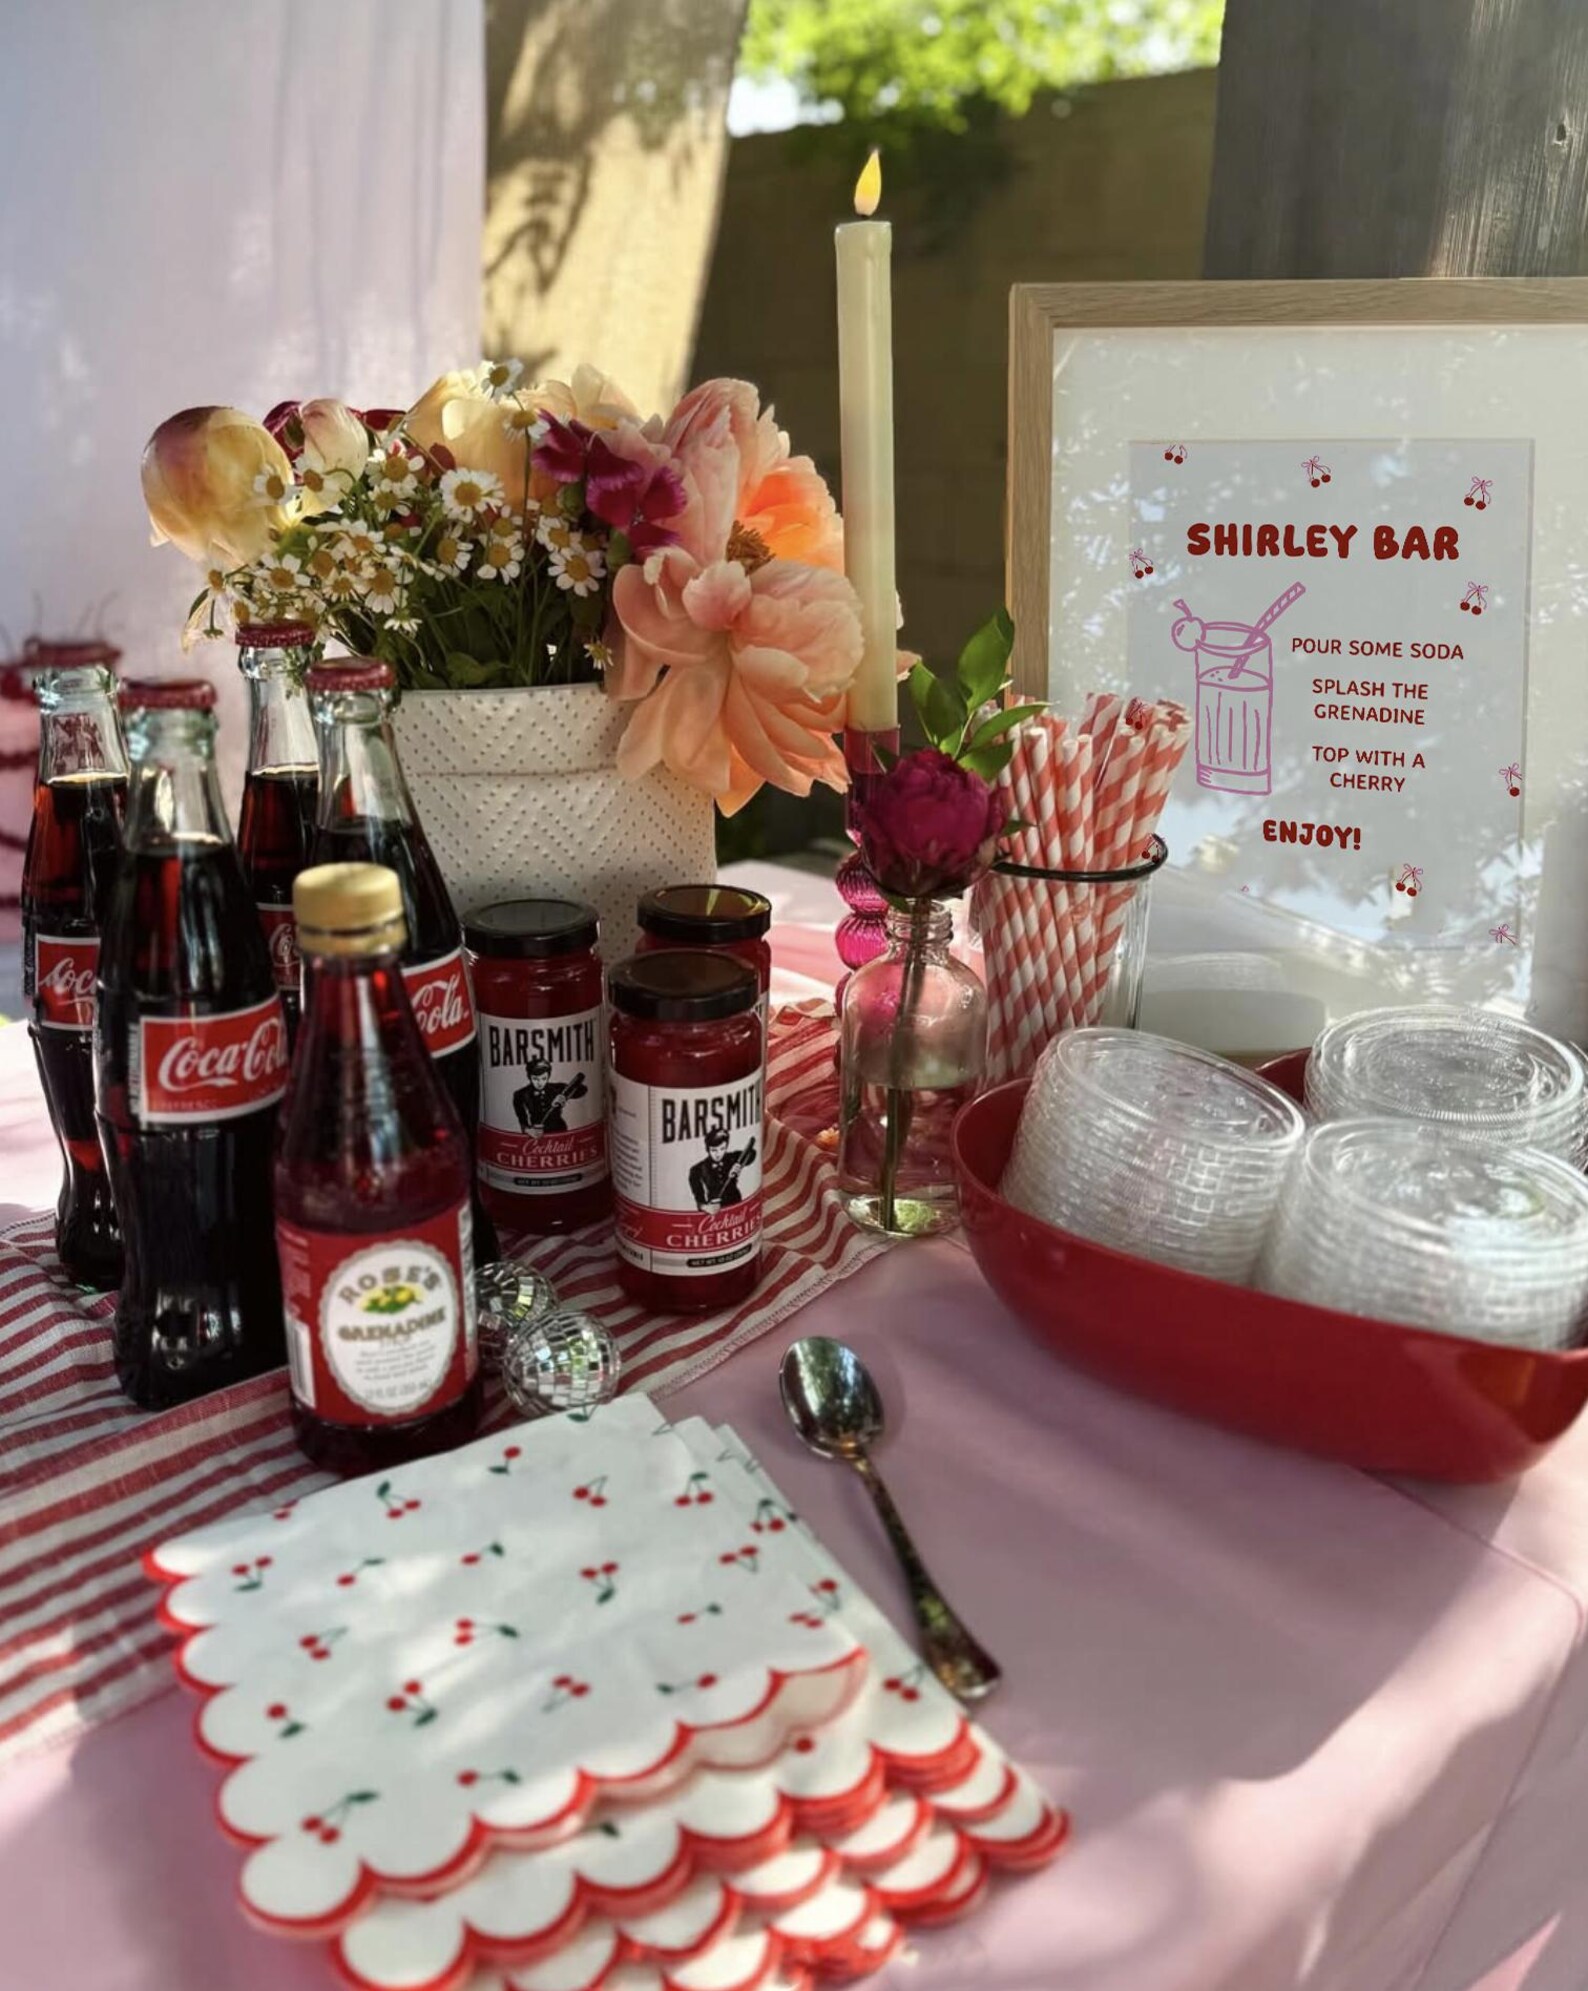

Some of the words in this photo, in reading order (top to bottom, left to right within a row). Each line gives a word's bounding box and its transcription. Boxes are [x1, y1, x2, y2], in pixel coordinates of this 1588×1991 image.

[1187, 522, 1358, 559] SHIRLEY
[1373, 525, 1460, 561] BAR
[1291, 637, 1342, 655] POUR
[1348, 640, 1403, 658] SOME
[1410, 642, 1464, 661] SODA
[1312, 678, 1386, 699] SPLASH
[1392, 682, 1429, 701] THE
[1313, 703, 1426, 726] GRENADINE
[1312, 744, 1349, 763] TOP
[1356, 750, 1406, 769] WITH
[1411, 752, 1426, 769] A
[1329, 771, 1406, 793] CHERRY
[1262, 820, 1362, 850] ENJOY!
[39, 957, 97, 995] Coc
[489, 1018, 595, 1068] BARSMITH
[522, 1136, 575, 1155] Cocktail
[698, 1206, 748, 1234] Cocktail
